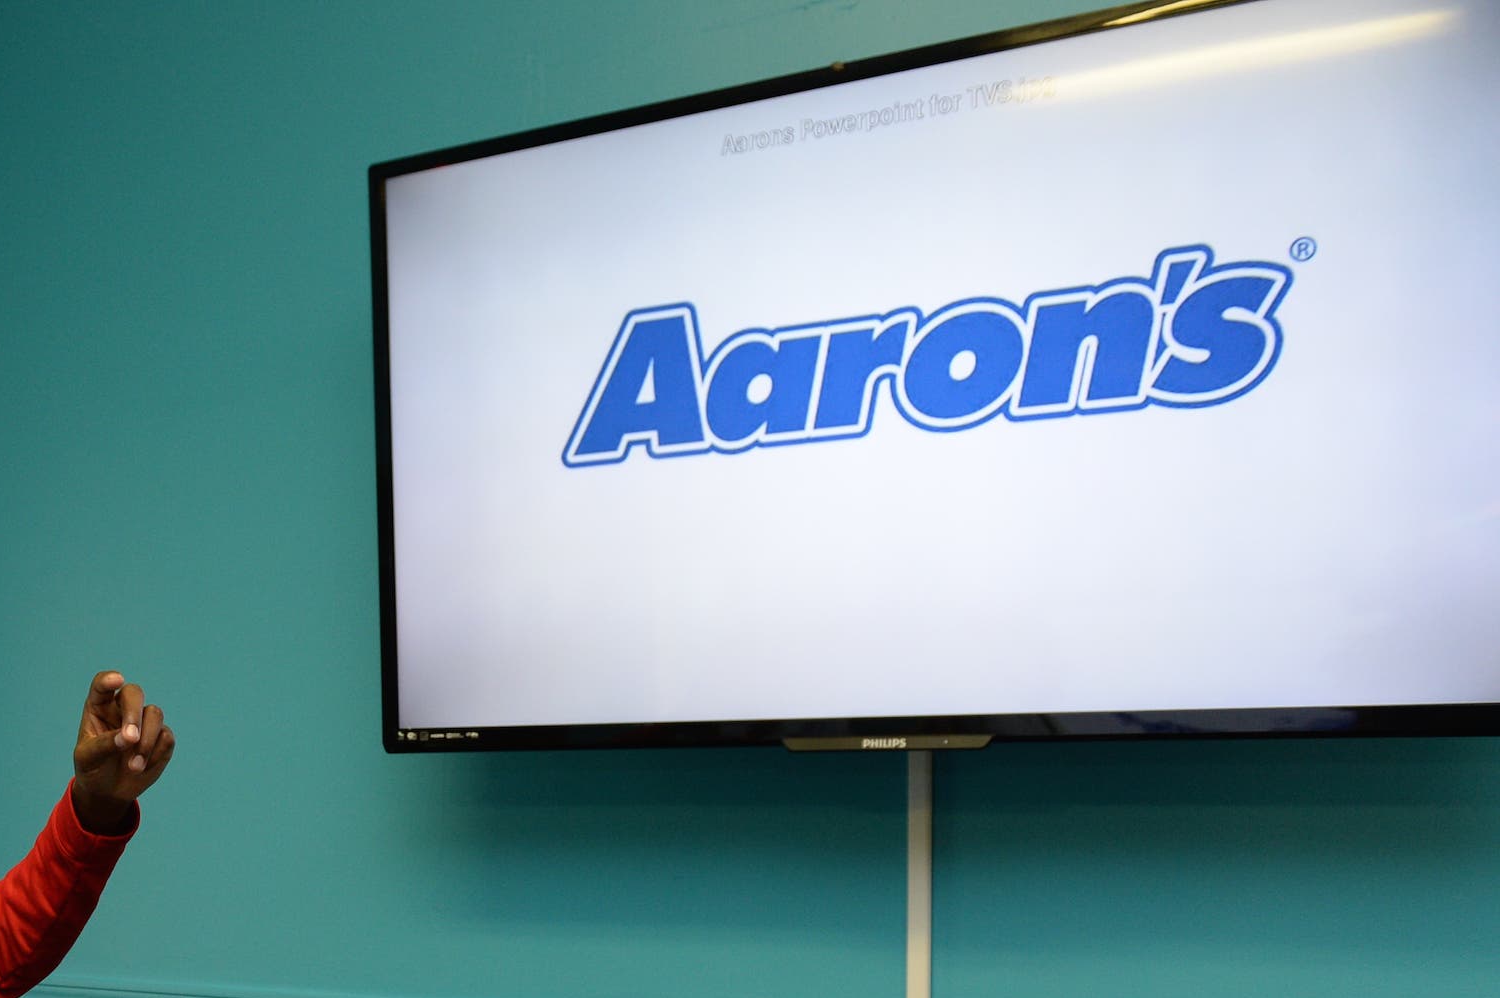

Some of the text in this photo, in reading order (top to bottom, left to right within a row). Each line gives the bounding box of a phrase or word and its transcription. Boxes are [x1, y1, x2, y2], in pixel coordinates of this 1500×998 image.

[721, 122, 795, 155] Aarons
[799, 97, 925, 143] Powerpoint
[929, 91, 962, 117] for
[561, 243, 1294, 468] Aaron's
[862, 738, 906, 749] PHILIPS
